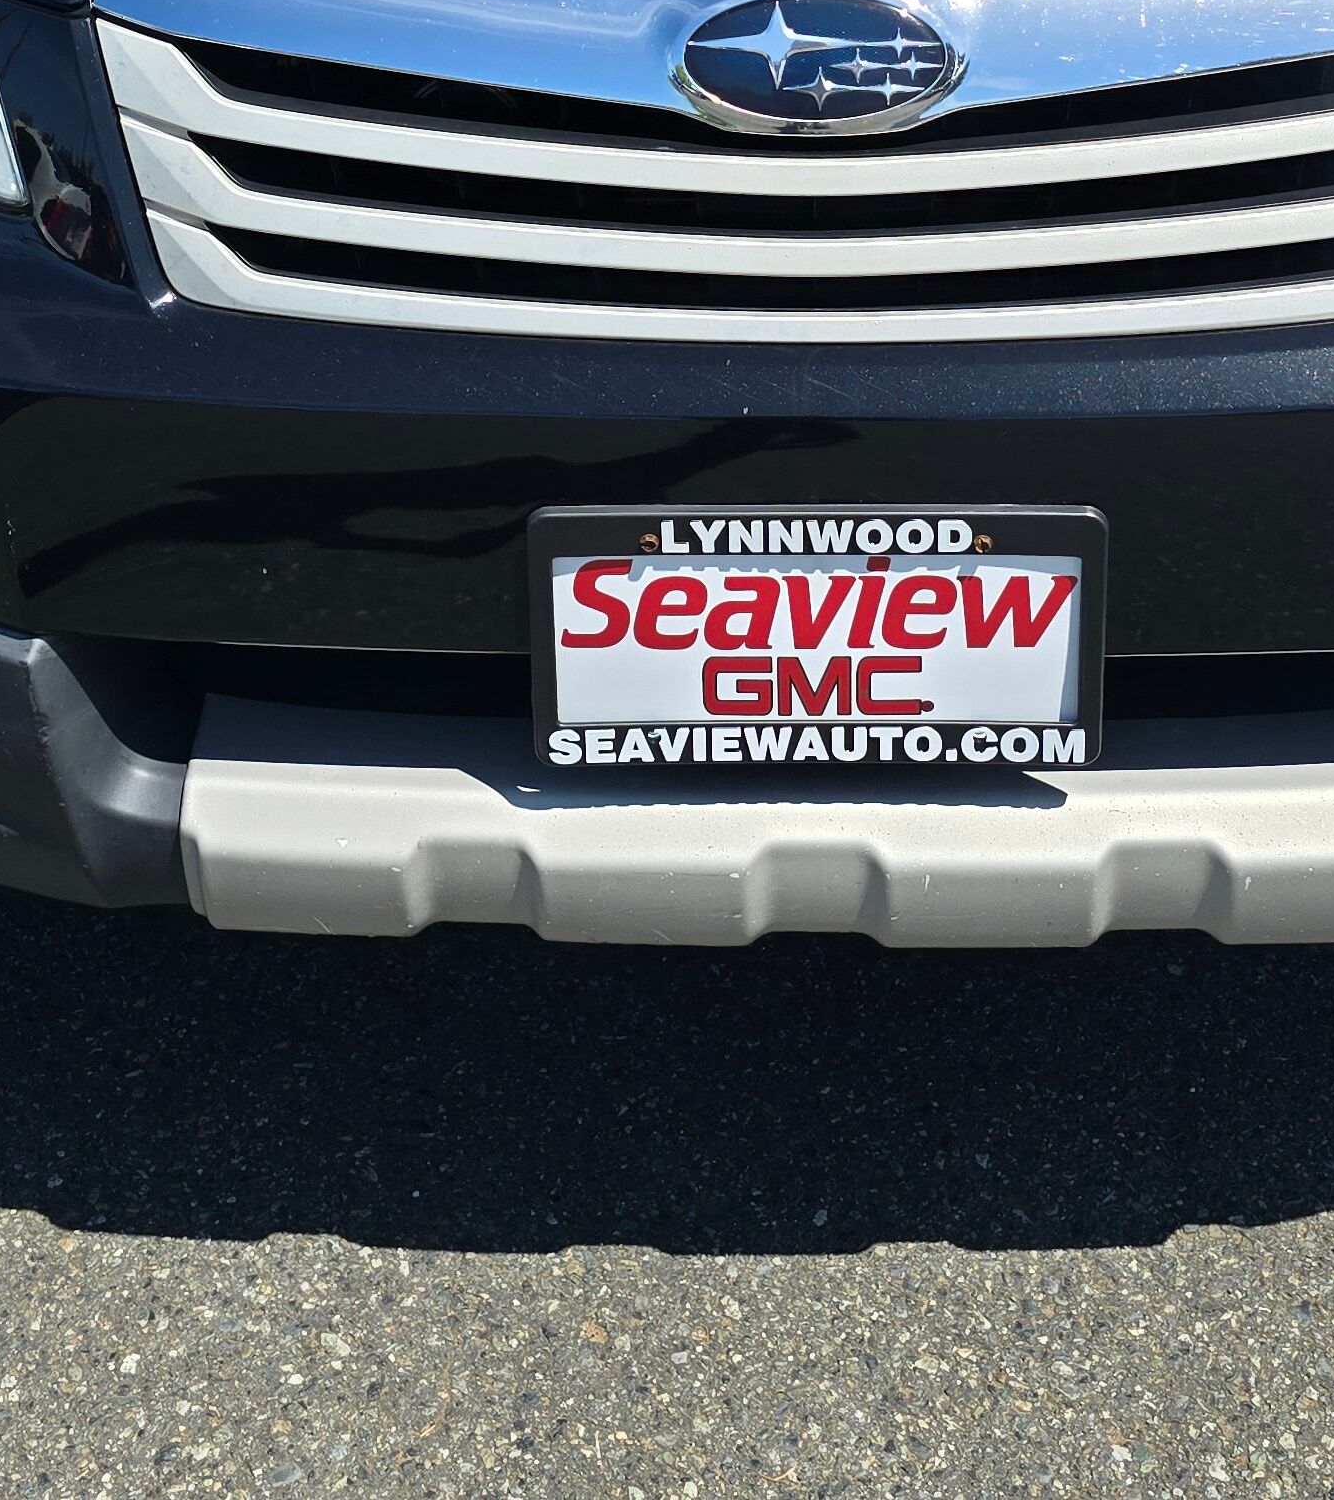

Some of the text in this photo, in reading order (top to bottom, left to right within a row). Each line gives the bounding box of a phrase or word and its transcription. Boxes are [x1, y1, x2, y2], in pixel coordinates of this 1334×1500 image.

[660, 519, 973, 554] LYNNWOOD
[560, 556, 1078, 650] Seaview
[702, 655, 934, 716] GMC
[548, 725, 1086, 765] SEAVIEWAUTO.COM
